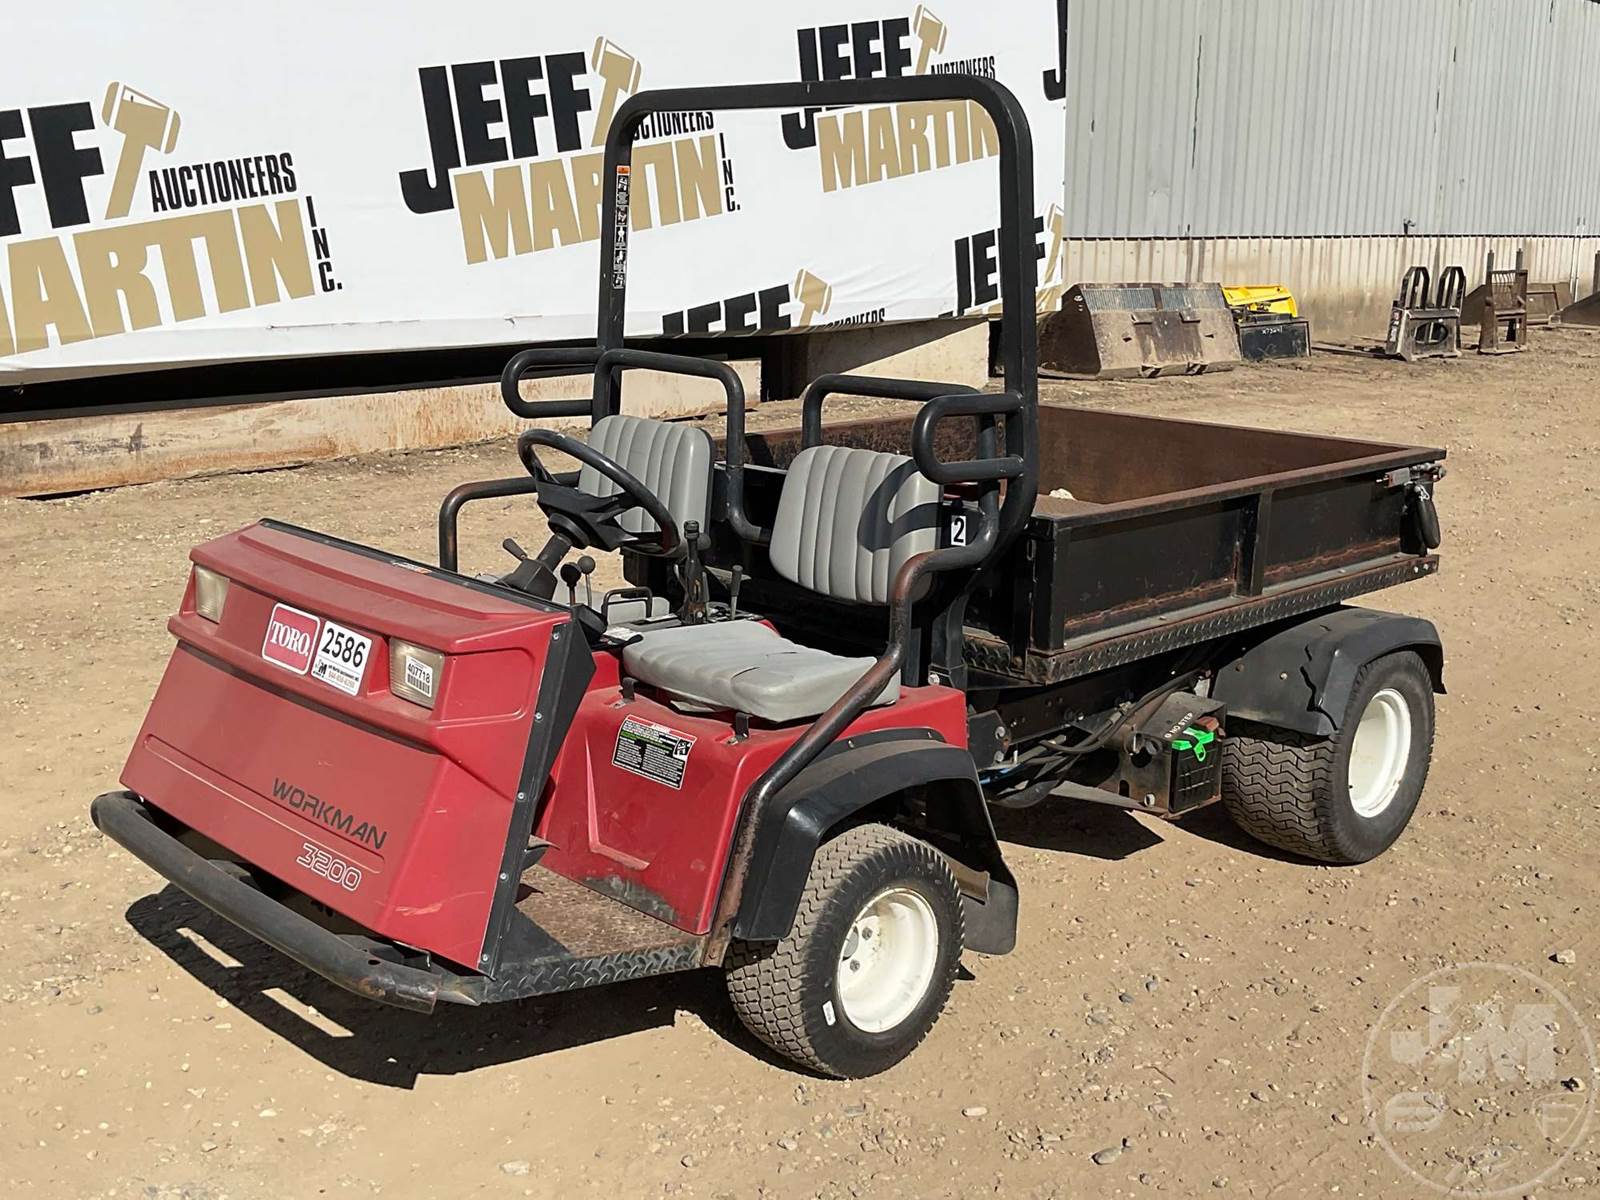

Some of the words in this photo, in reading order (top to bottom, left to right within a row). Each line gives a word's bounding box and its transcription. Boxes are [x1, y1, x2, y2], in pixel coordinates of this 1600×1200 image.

[399, 52, 591, 214] JEFF
[148, 152, 297, 213] AUCTIONEERS
[0, 198, 315, 357] ARTIN
[952, 516, 966, 544] 2
[321, 627, 366, 668] 2586
[407, 662, 431, 684] 407718
[272, 777, 388, 850] WORKMAN
[296, 842, 362, 892] 3200
